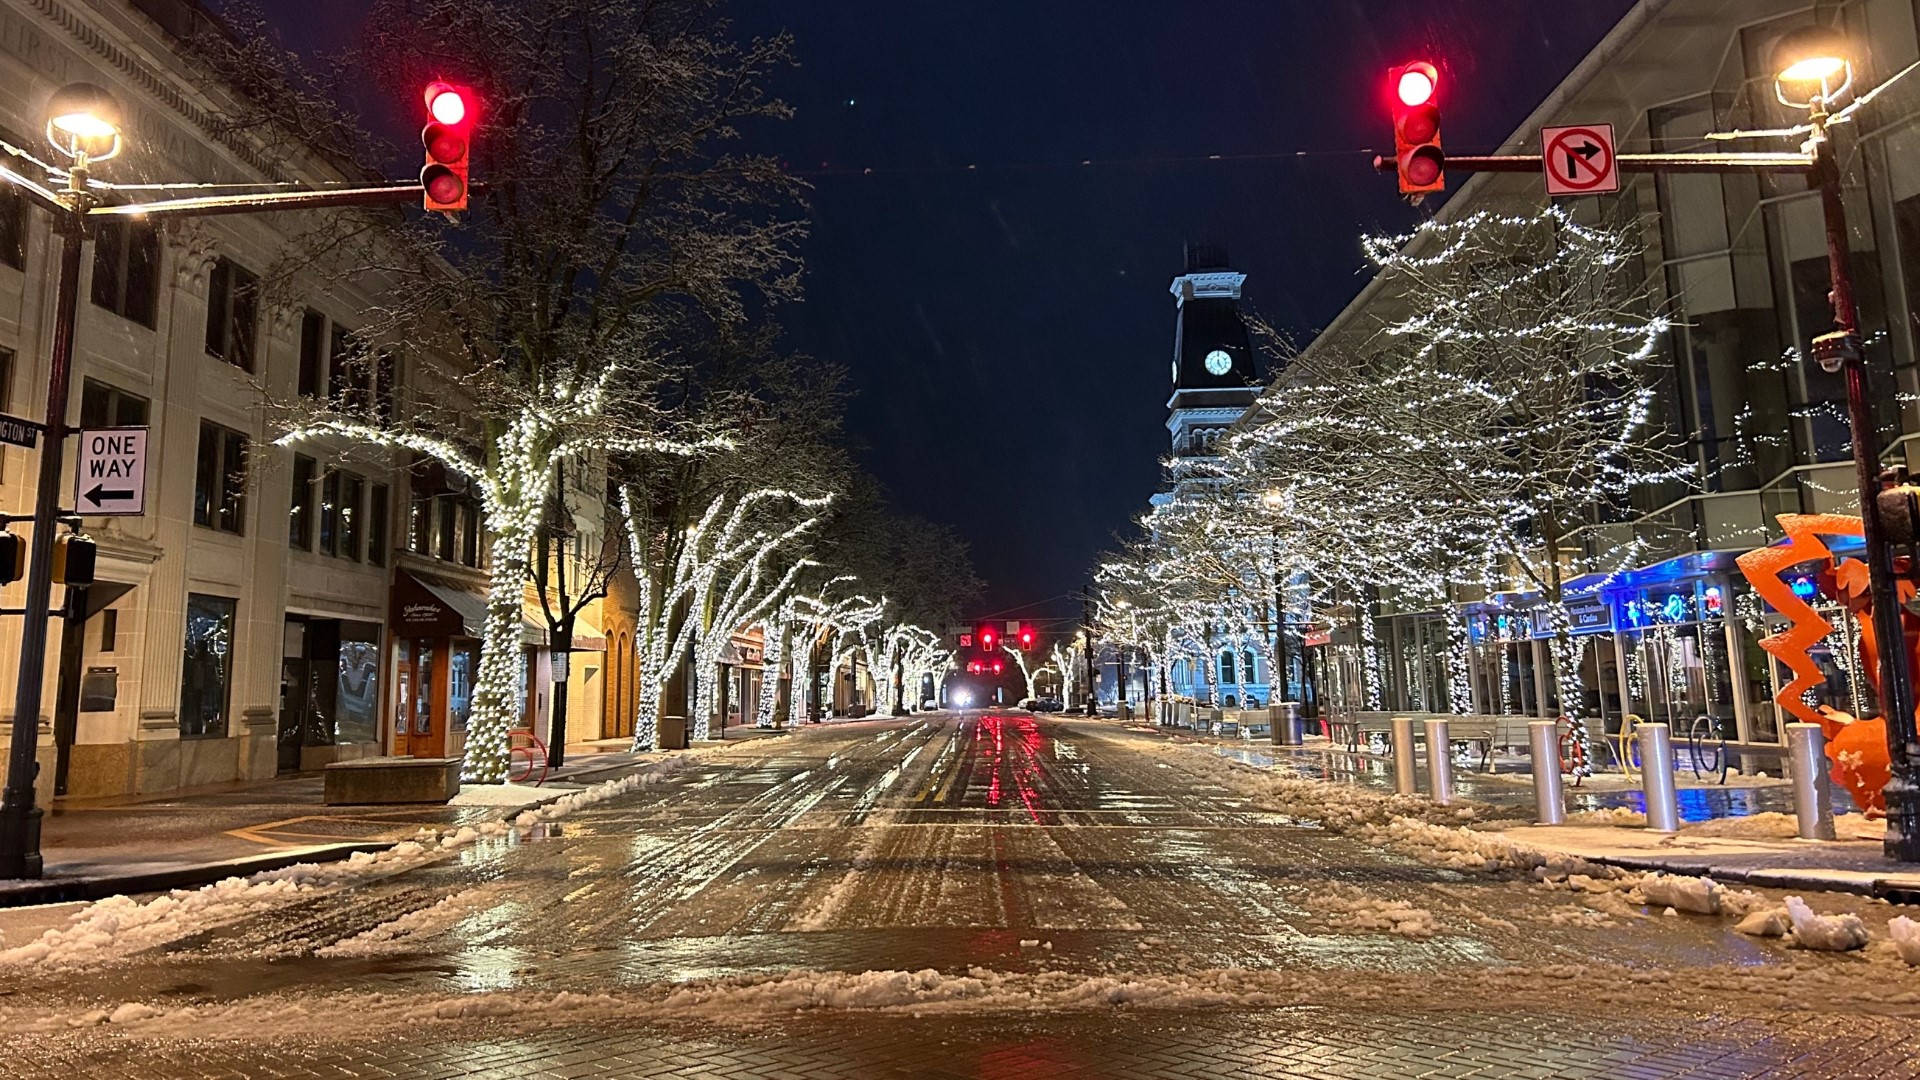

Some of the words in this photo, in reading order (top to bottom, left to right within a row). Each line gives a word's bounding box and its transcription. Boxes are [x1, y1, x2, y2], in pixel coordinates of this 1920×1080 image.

[3, 13, 71, 82] FIRST
[0, 420, 25, 443] GTON
[27, 427, 36, 439] ST
[92, 436, 136, 455] ONE
[90, 459, 136, 478] WAY
